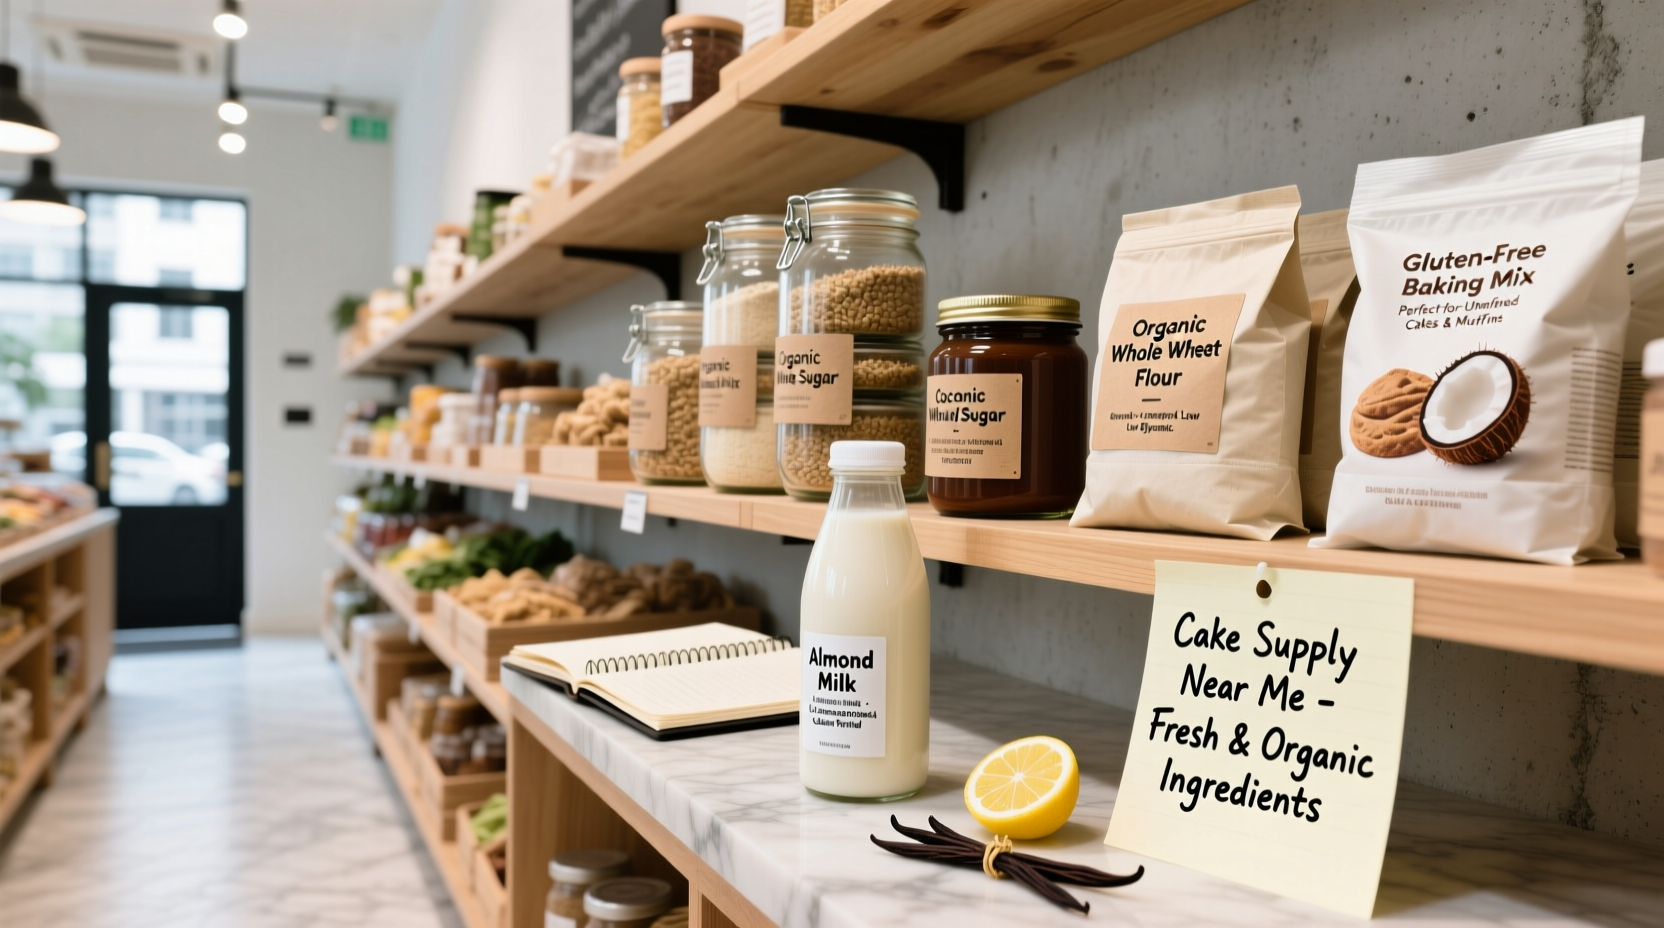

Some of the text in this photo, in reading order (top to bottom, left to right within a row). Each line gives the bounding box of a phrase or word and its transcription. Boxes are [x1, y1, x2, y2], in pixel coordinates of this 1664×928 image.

[1403, 243, 1546, 272] Gluten-Free
[1402, 267, 1535, 297] Baking Mix
[1132, 314, 1207, 342] Organic
[1112, 342, 1163, 362] Whole
[798, 369, 839, 388] Sugar
[1134, 368, 1182, 387] Flour
[960, 407, 1006, 427] Sugar
[808, 646, 874, 670] Almond
[1173, 611, 1358, 684] Cake Supply
[818, 671, 857, 693] Milk
[1180, 663, 1249, 702] Near
[1258, 673, 1305, 712] Me
[1149, 707, 1374, 782] Fresh & Organic
[1159, 757, 1322, 823] Ingredients
